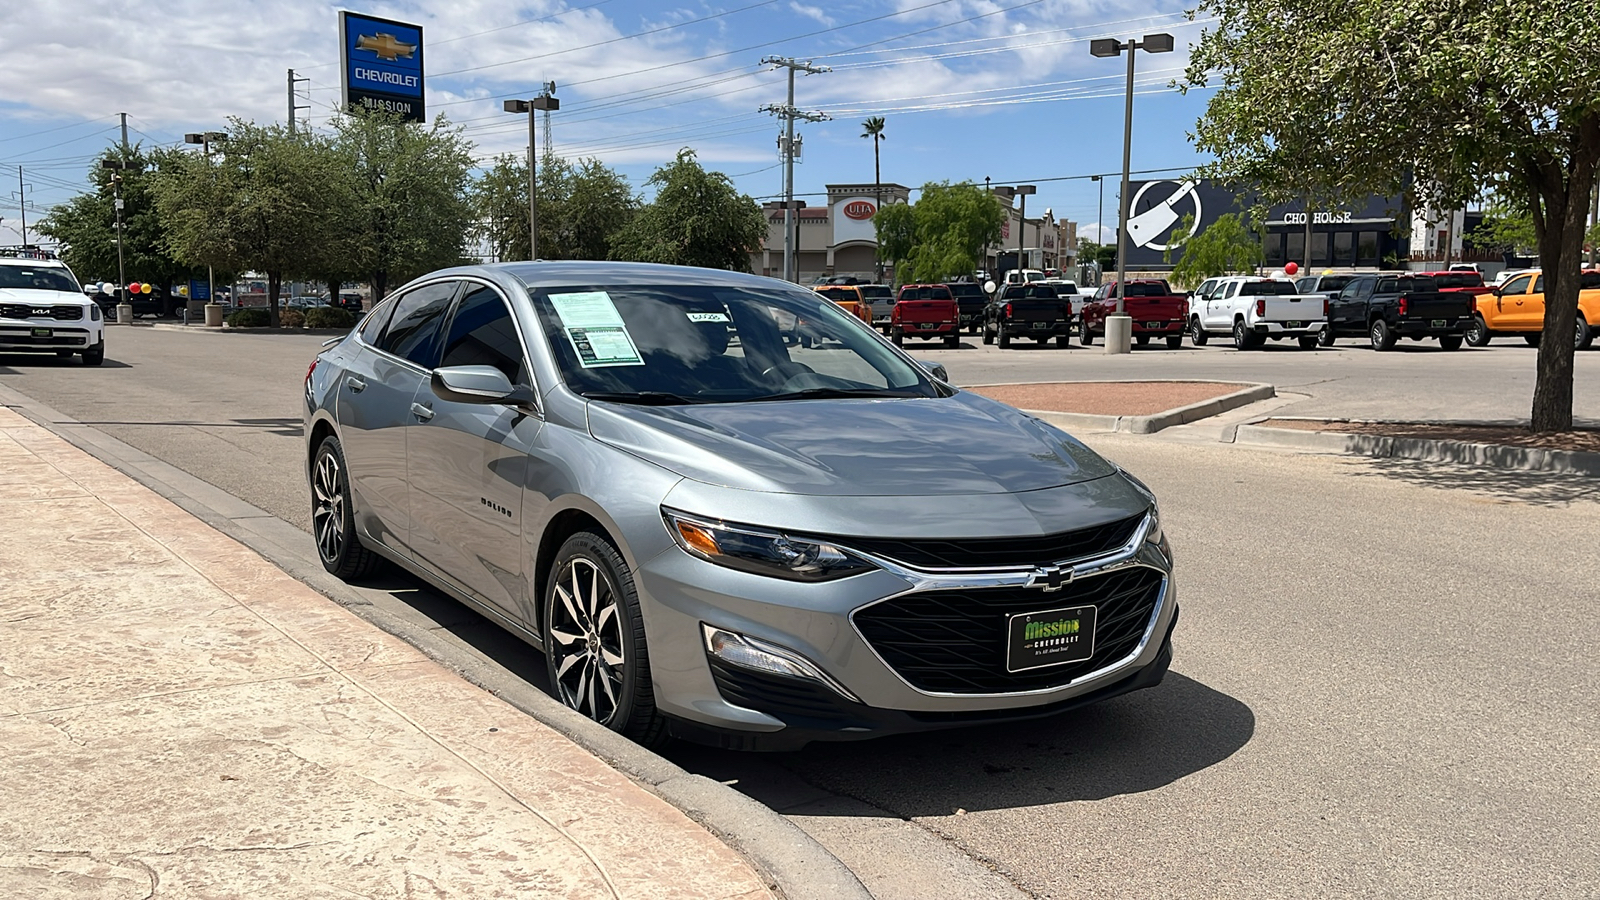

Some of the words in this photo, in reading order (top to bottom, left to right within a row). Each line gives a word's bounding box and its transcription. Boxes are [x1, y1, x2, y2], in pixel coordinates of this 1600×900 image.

[355, 67, 418, 87] CHEVROLET
[849, 204, 872, 213] ULTA
[1313, 212, 1351, 224] HOUSE
[1034, 635, 1079, 648] CHEVROLET
